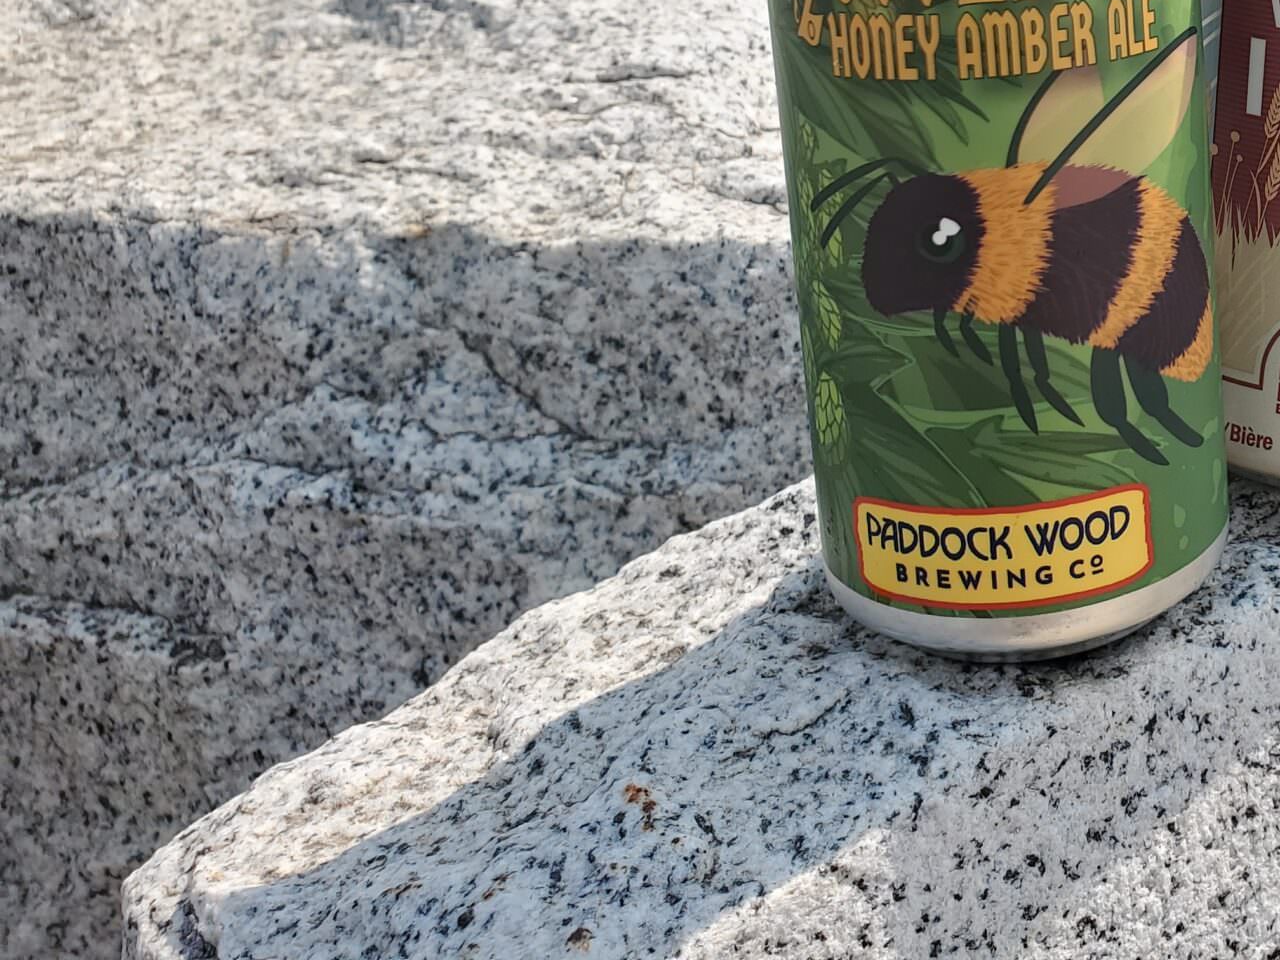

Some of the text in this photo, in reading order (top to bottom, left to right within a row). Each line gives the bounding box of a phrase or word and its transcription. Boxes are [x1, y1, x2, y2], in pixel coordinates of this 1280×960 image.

[828, 11, 940, 81] HONEY
[957, 0, 1098, 80] AMBER
[866, 505, 1131, 561] PADDOCK WOOD
[895, 563, 1055, 590] BREWING
